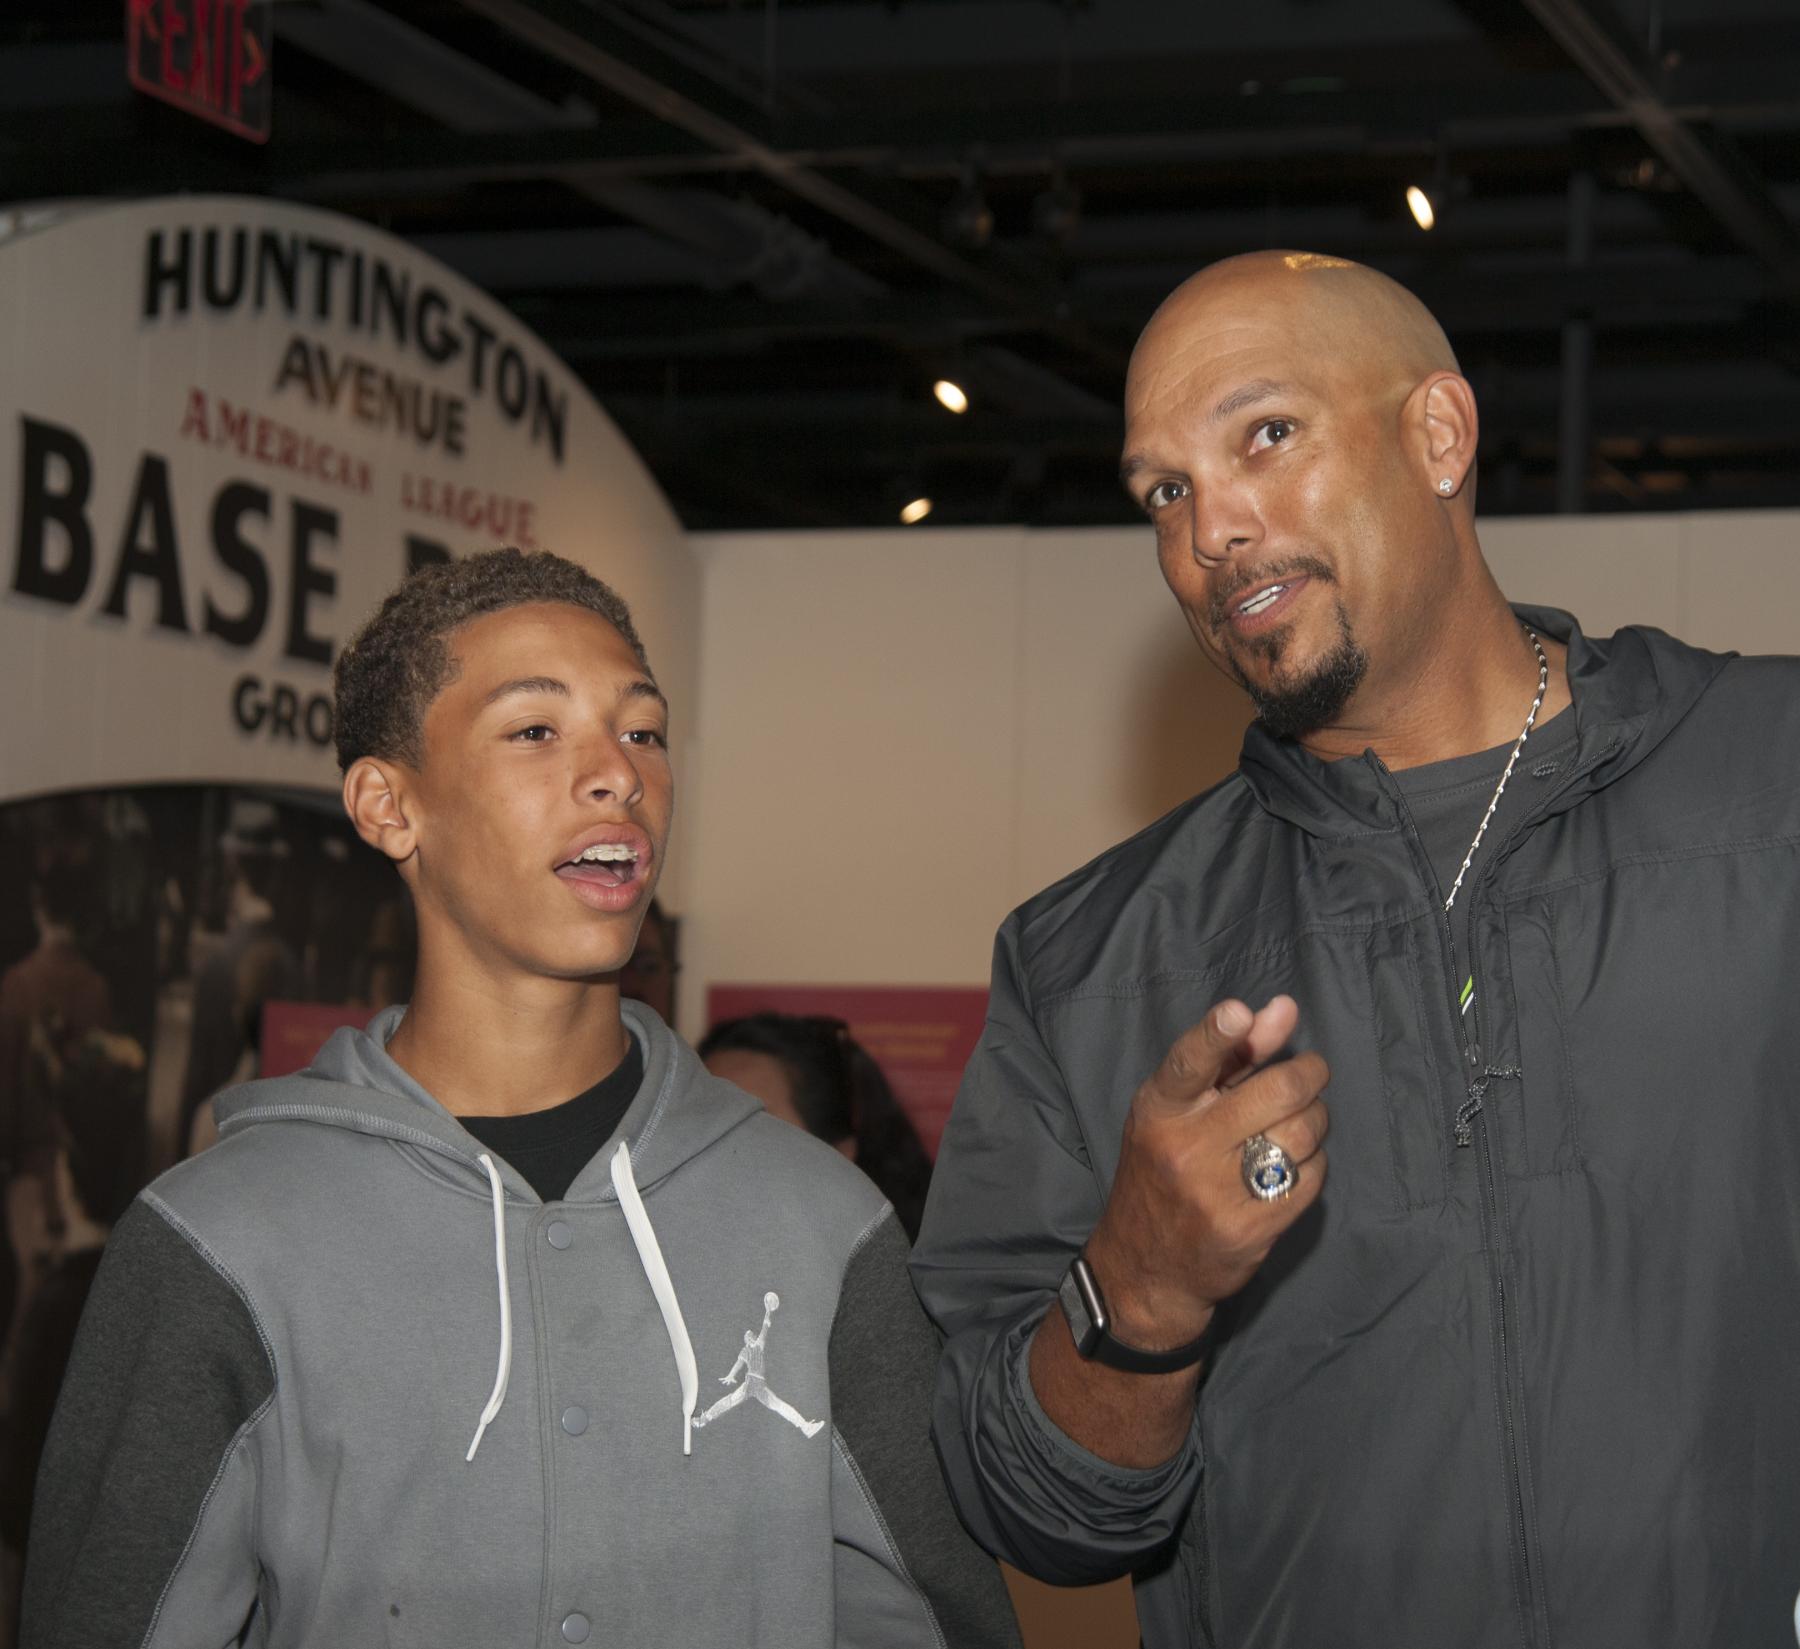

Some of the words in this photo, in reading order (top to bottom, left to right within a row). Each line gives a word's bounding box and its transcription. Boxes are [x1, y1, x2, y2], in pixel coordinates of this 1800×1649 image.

[142, 224, 568, 465] HUNTINGTON
[276, 334, 468, 458] AVENUE
[11, 410, 341, 668] BASE
[181, 386, 374, 496] AMERICAN
[400, 472, 538, 550] LEAGUE
